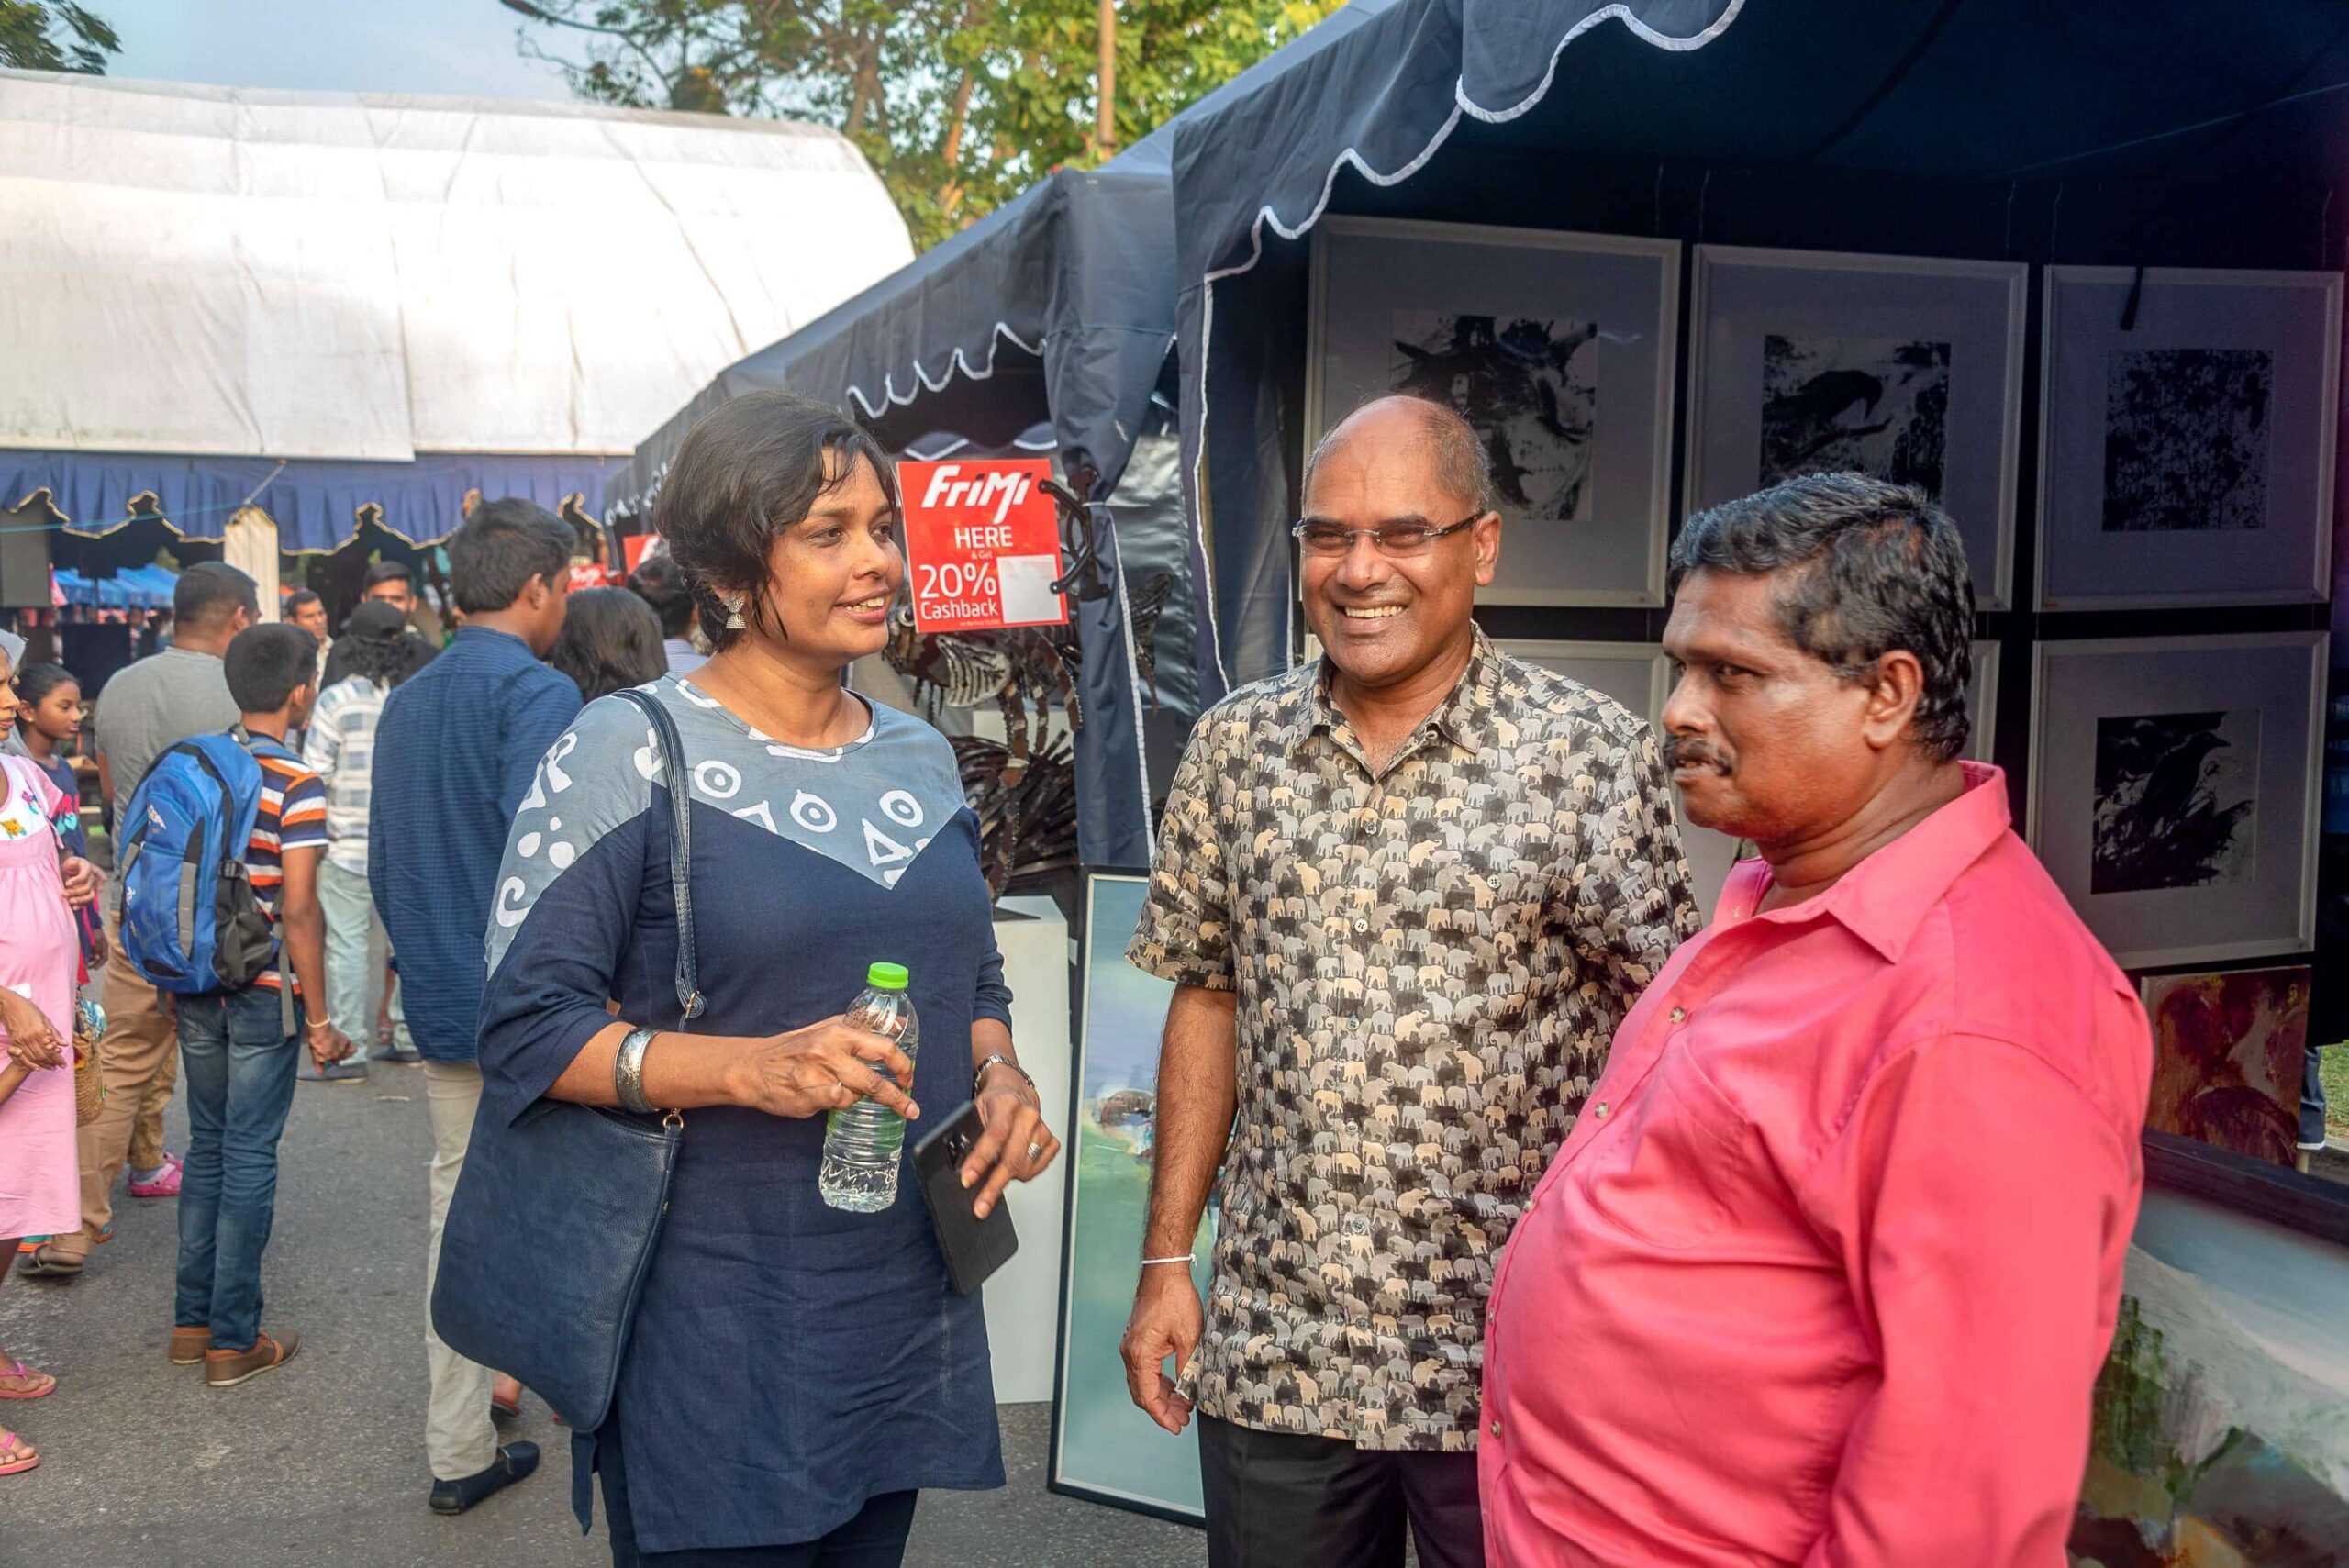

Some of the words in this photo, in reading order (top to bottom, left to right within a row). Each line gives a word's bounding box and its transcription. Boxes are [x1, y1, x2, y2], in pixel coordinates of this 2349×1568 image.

[921, 464, 1033, 524] FriMi
[954, 526, 1013, 549] HERE
[919, 562, 997, 598] 20%
[920, 598, 999, 620] Cashback
